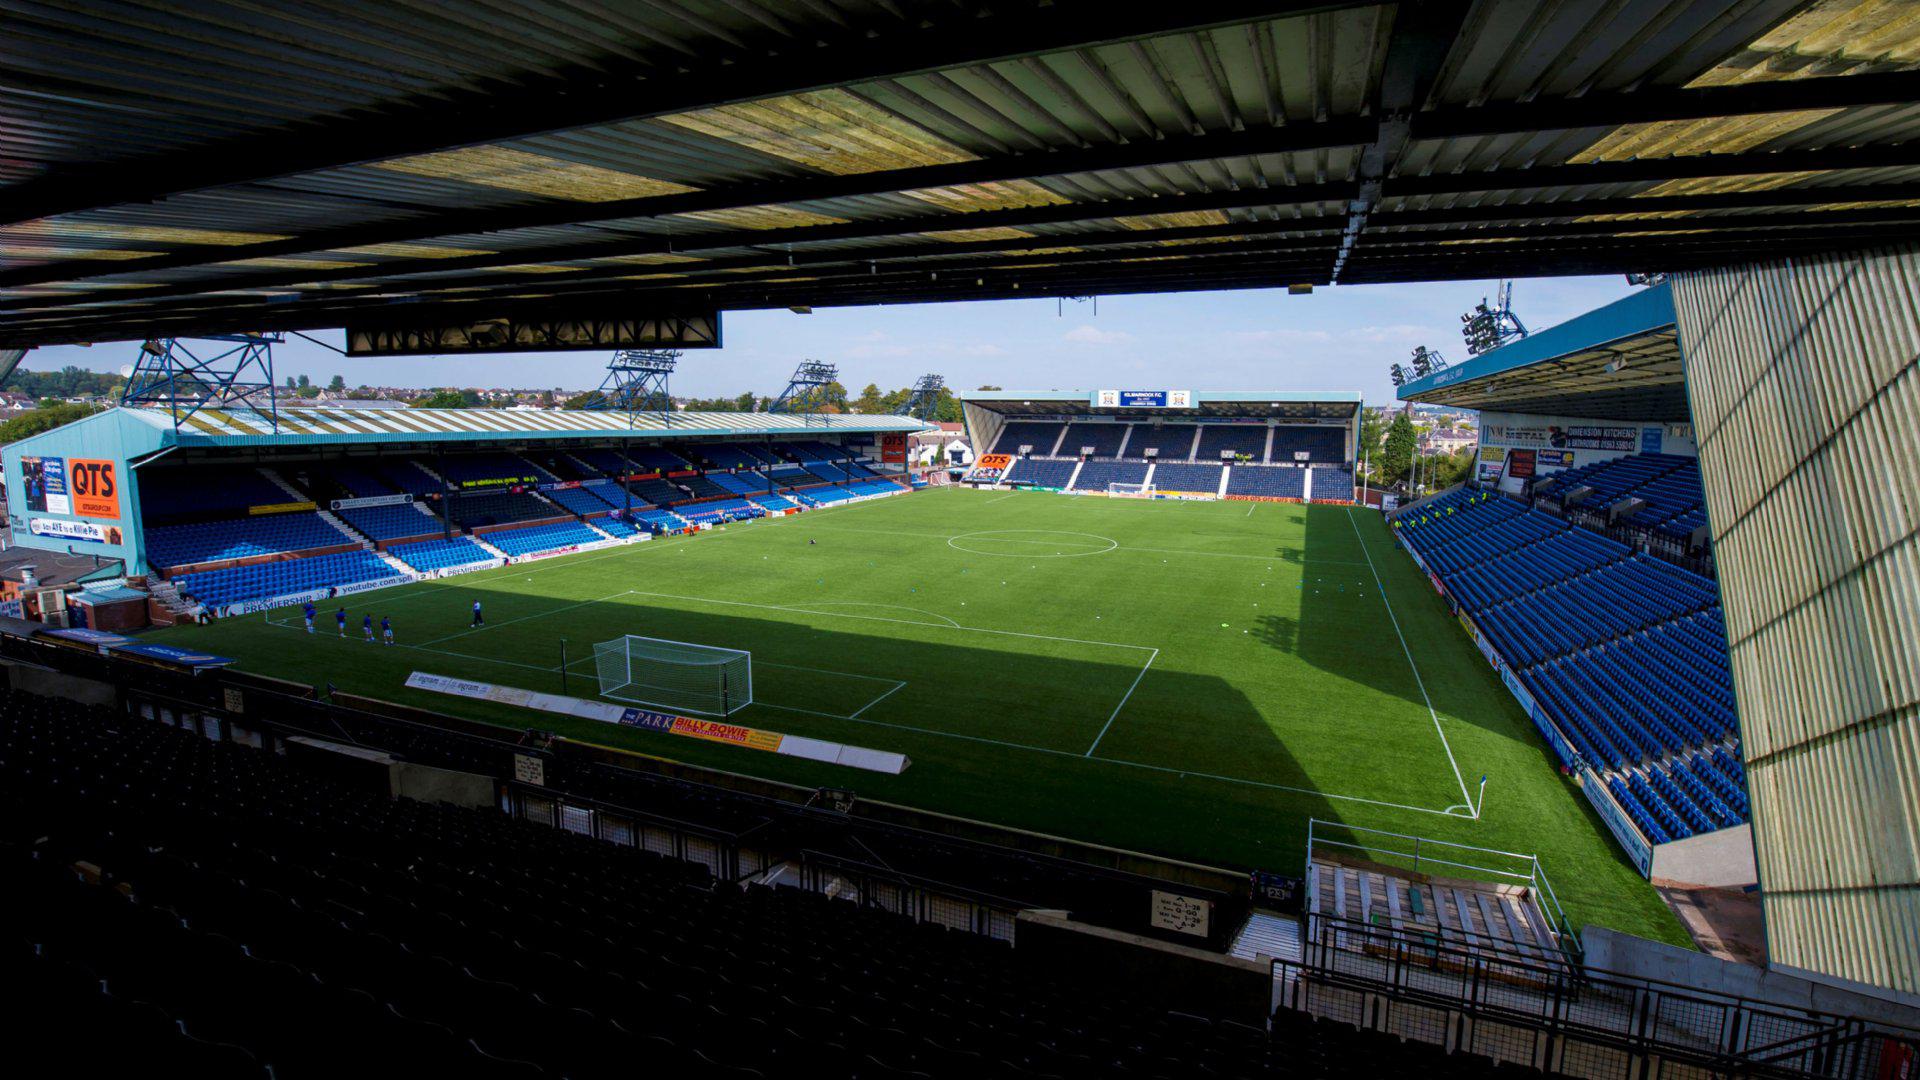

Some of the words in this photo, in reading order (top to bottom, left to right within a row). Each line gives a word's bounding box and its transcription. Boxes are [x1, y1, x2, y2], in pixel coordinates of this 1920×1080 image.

[1568, 428, 1602, 437] DIMENSION
[1603, 429, 1636, 439] KITCHENS
[1571, 439, 1600, 448] BATHROOMS
[981, 455, 1007, 464] QTS
[72, 463, 113, 498] QTS
[52, 522, 63, 532] AYE
[88, 528, 99, 537] Pie
[447, 562, 493, 576] PREMIERSHIP
[243, 595, 312, 613] PREMIERSHIP
[635, 711, 675, 729] PARK
[675, 717, 708, 730] BILLY
[709, 722, 750, 738] BOWIE
